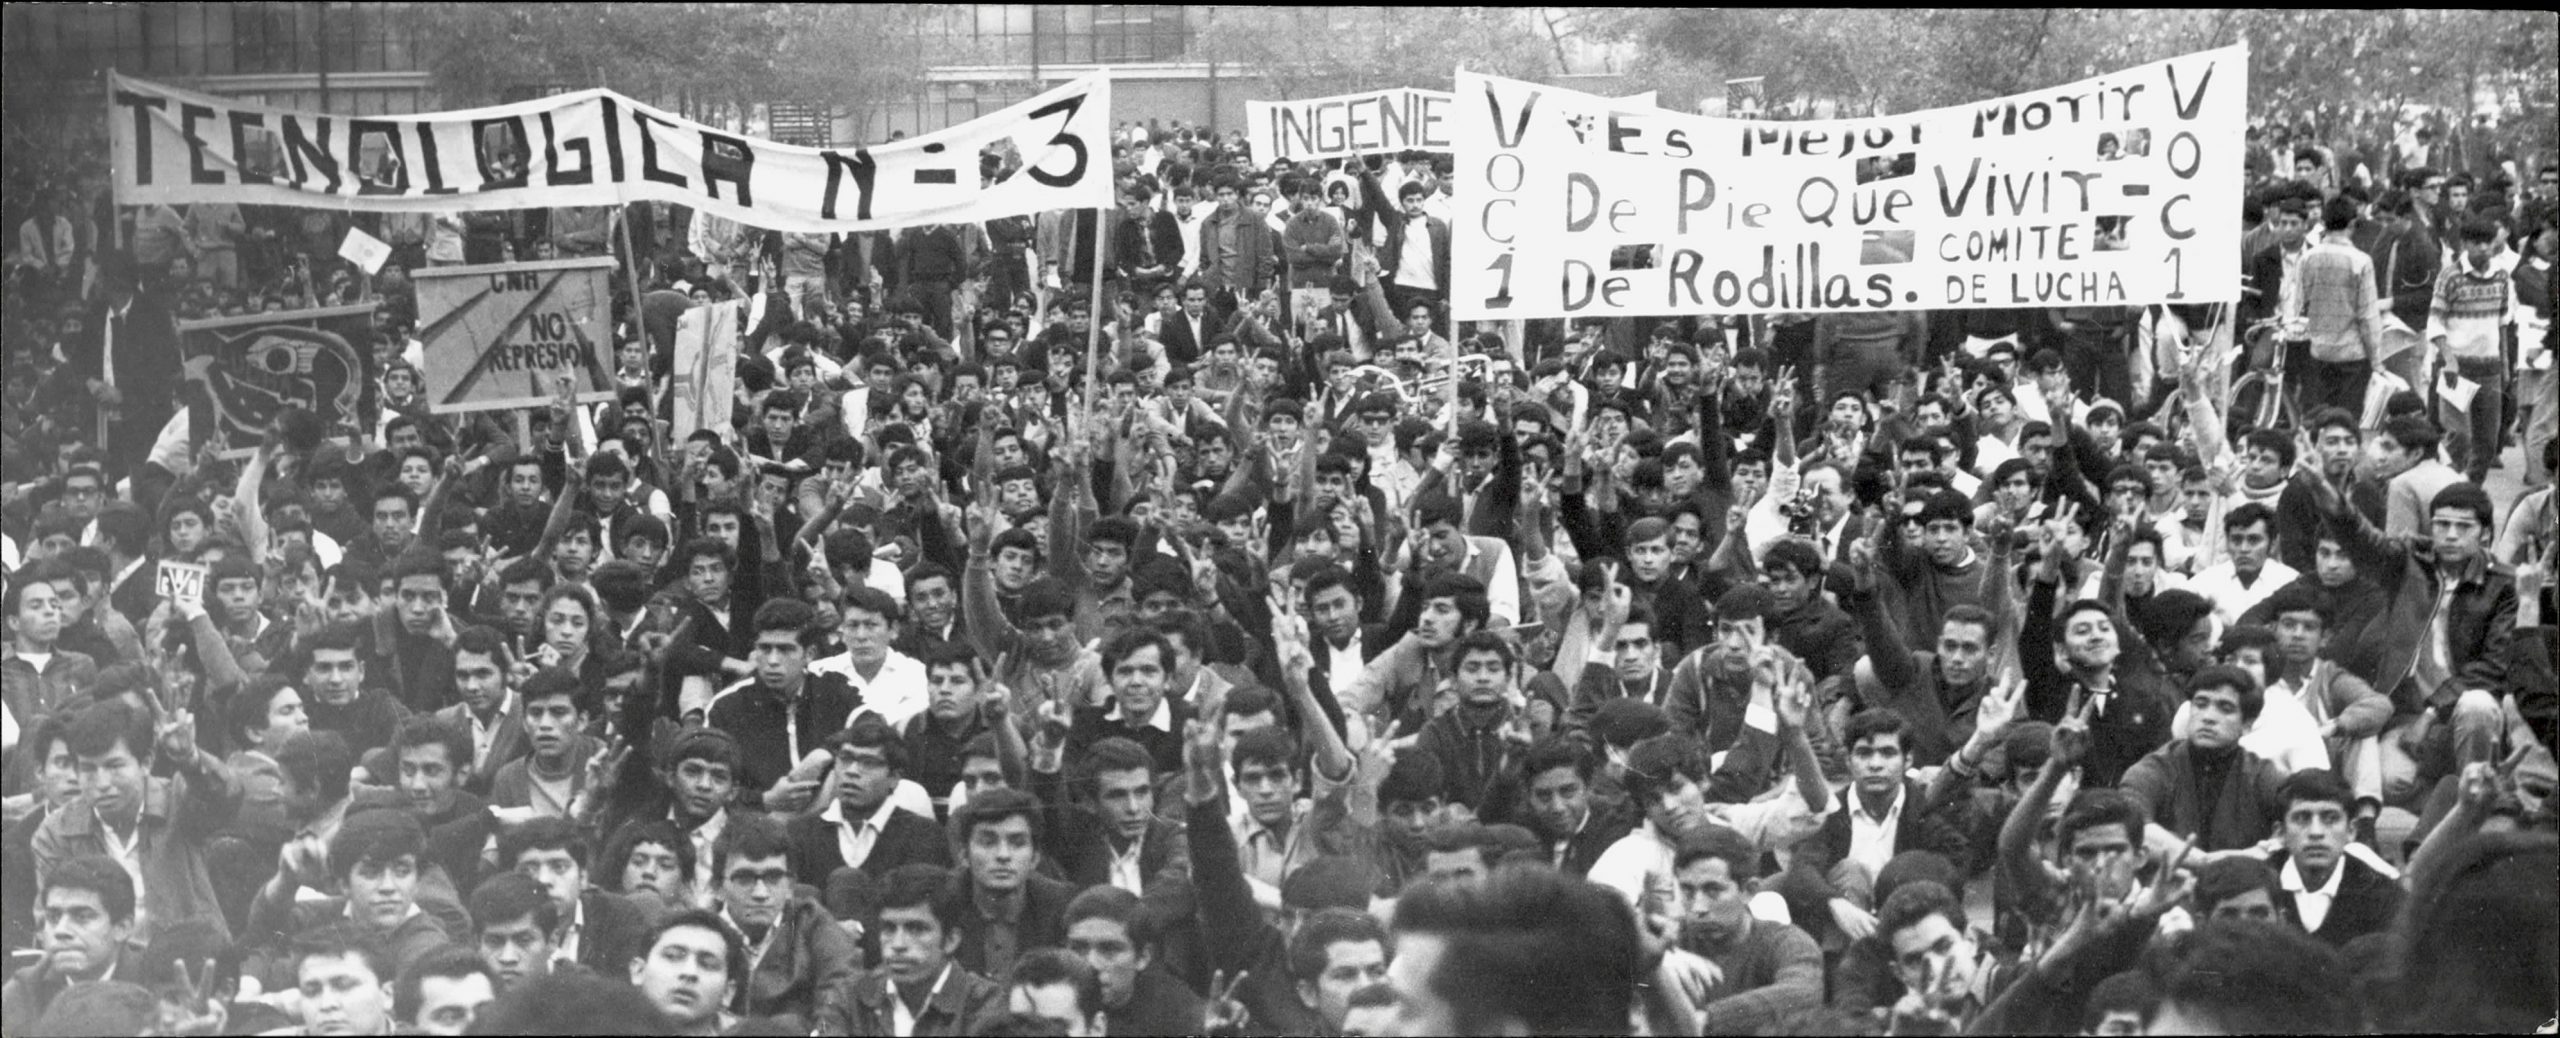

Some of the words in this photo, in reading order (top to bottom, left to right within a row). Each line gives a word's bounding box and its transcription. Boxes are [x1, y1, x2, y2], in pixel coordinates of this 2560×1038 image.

[115, 90, 755, 208] TECNOLOGICA
[1026, 93, 1089, 187] 3
[1566, 171, 1638, 234] De
[1678, 168, 1772, 235] Pie
[1796, 176, 1914, 228] Que
[1939, 223, 2080, 263] COMITE
[1562, 259, 1632, 312] De
[1945, 274, 1988, 305] DE
[2010, 271, 2127, 304] LUCHA
[530, 312, 567, 342] NO
